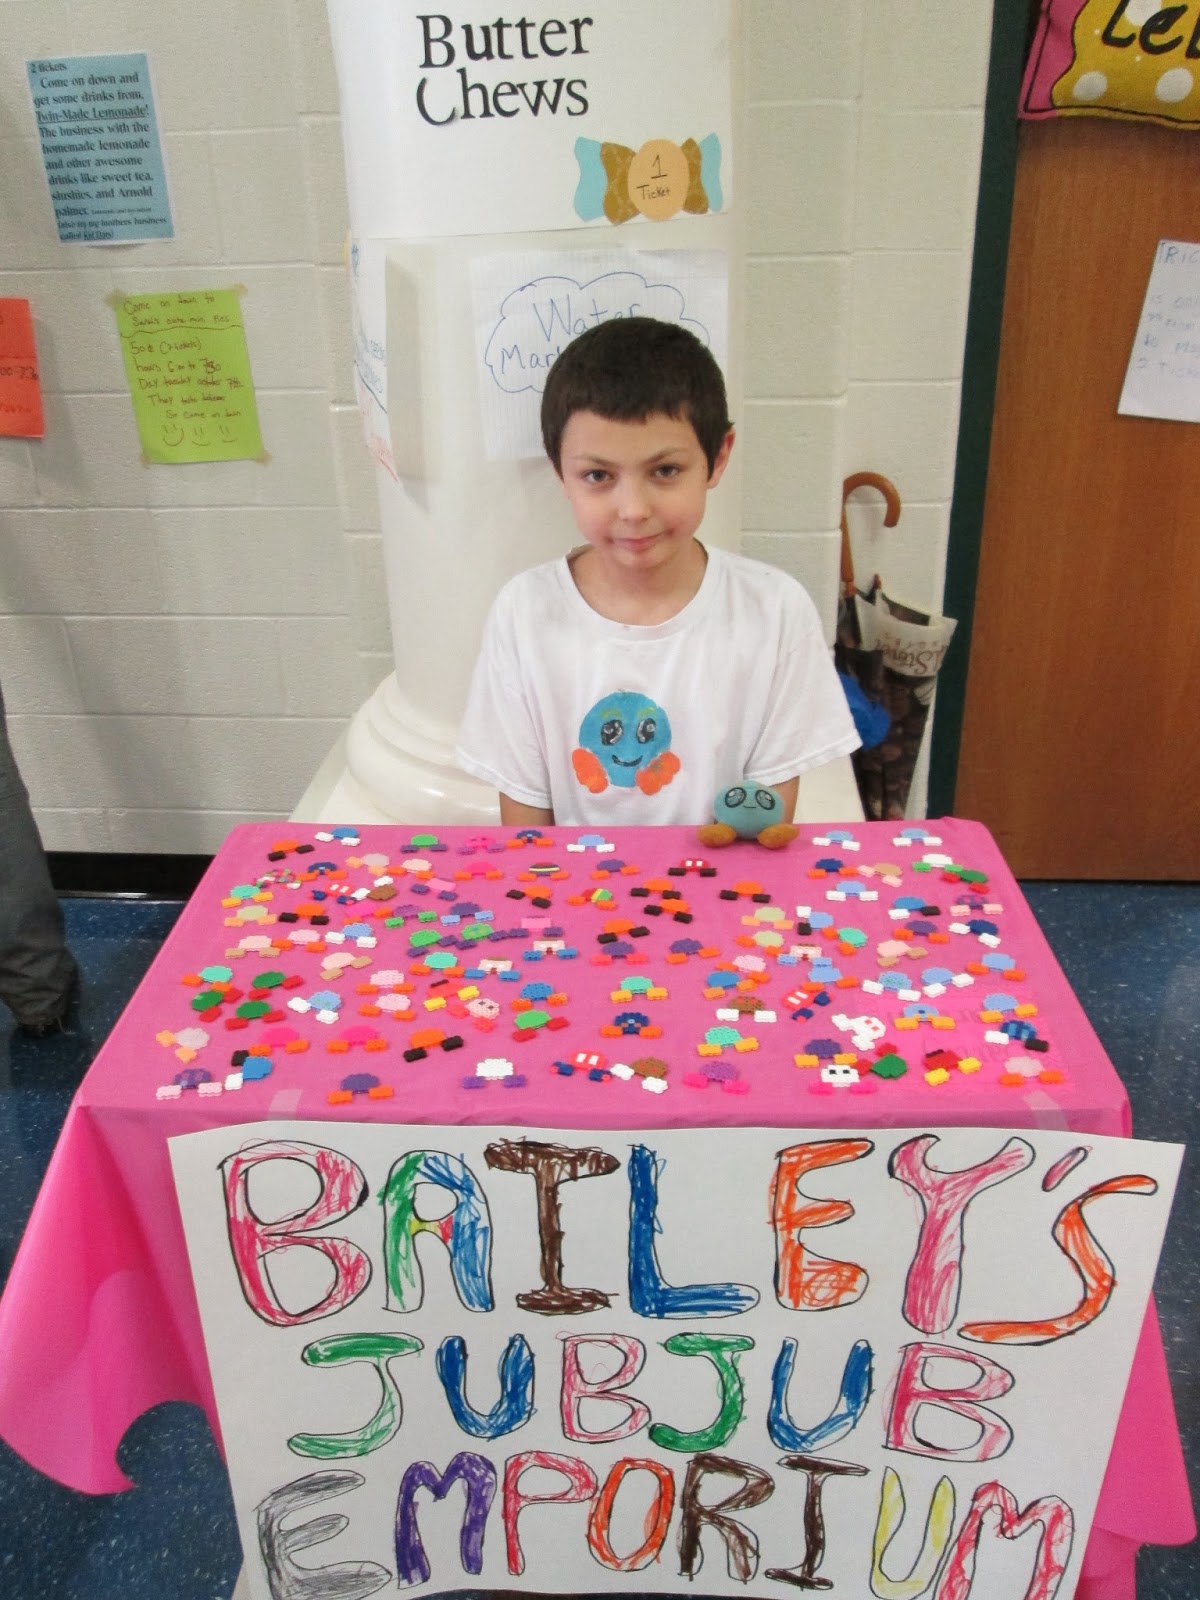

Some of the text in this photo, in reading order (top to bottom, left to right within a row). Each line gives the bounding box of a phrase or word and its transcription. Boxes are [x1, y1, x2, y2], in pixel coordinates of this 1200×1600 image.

[416, 14, 593, 69] Butter
[31, 63, 67, 74] 2 tickets
[40, 72, 139, 89] Come on down and
[33, 95, 51, 108] get
[53, 94, 78, 104] some
[81, 91, 115, 102] drinks
[416, 67, 589, 126] Chews
[36, 107, 89, 122] Twin-Made
[39, 121, 150, 138] The business with the
[41, 138, 150, 155] homemade lemonade
[46, 155, 143, 170] and other awesome
[651, 154, 668, 179] 1
[49, 173, 79, 186] drinks
[80, 172, 99, 184] like
[101, 171, 132, 183] sweet
[95, 187, 115, 199] and
[118, 186, 153, 197] Arnold
[636, 184, 671, 201] Ticket
[134, 216, 168, 225] business
[123, 300, 150, 316] Come
[218, 1134, 1158, 1346] BAILEY'S
[253, 1450, 1076, 1600] EMPORIUM
